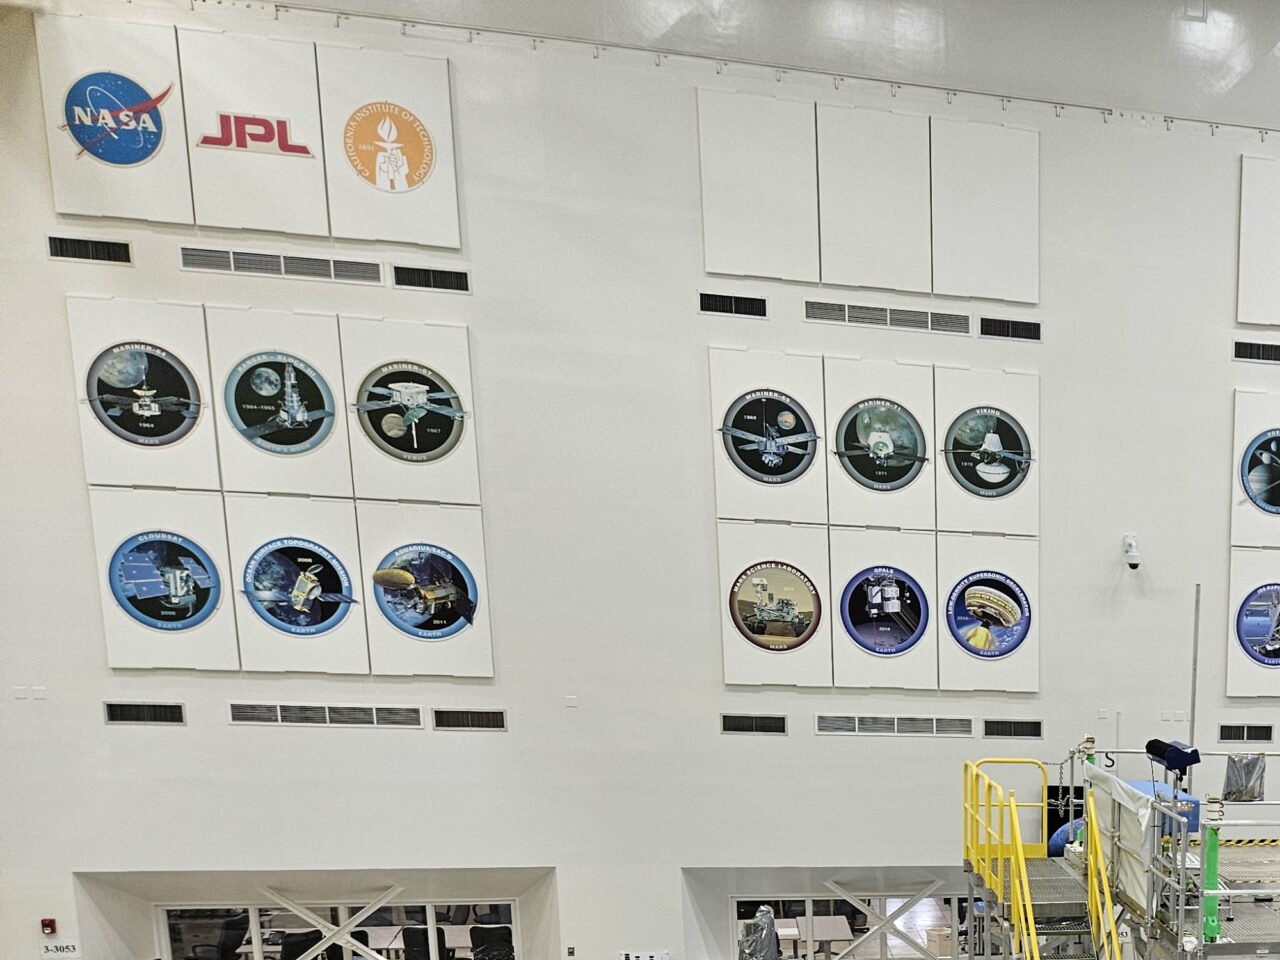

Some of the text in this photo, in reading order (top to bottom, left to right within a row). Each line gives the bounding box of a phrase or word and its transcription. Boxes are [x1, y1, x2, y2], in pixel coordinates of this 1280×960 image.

[73, 106, 157, 132] NASA
[200, 114, 311, 155] JPL
[345, 104, 432, 182] CALIFORNIA INSTITUTE OF TECHNOLOGY
[112, 344, 166, 357] MARINER-64
[237, 354, 268, 372] RANGER
[277, 354, 305, 369] BLOCK
[381, 363, 432, 376] MARINER-67
[858, 400, 901, 411] MARINER-71
[976, 408, 1000, 416] VIKING
[138, 533, 182, 542] CLOUDSAT
[245, 539, 350, 587] OCEAN SURFACE TOPOGRAPHY MISSION
[733, 563, 816, 595] MARS SCIENCE LABORATORY
[968, 572, 1006, 581] SUPERSONIC
[1006, 578, 1030, 617] DECELERATOR
[43, 944, 77, 954] 3-3053
